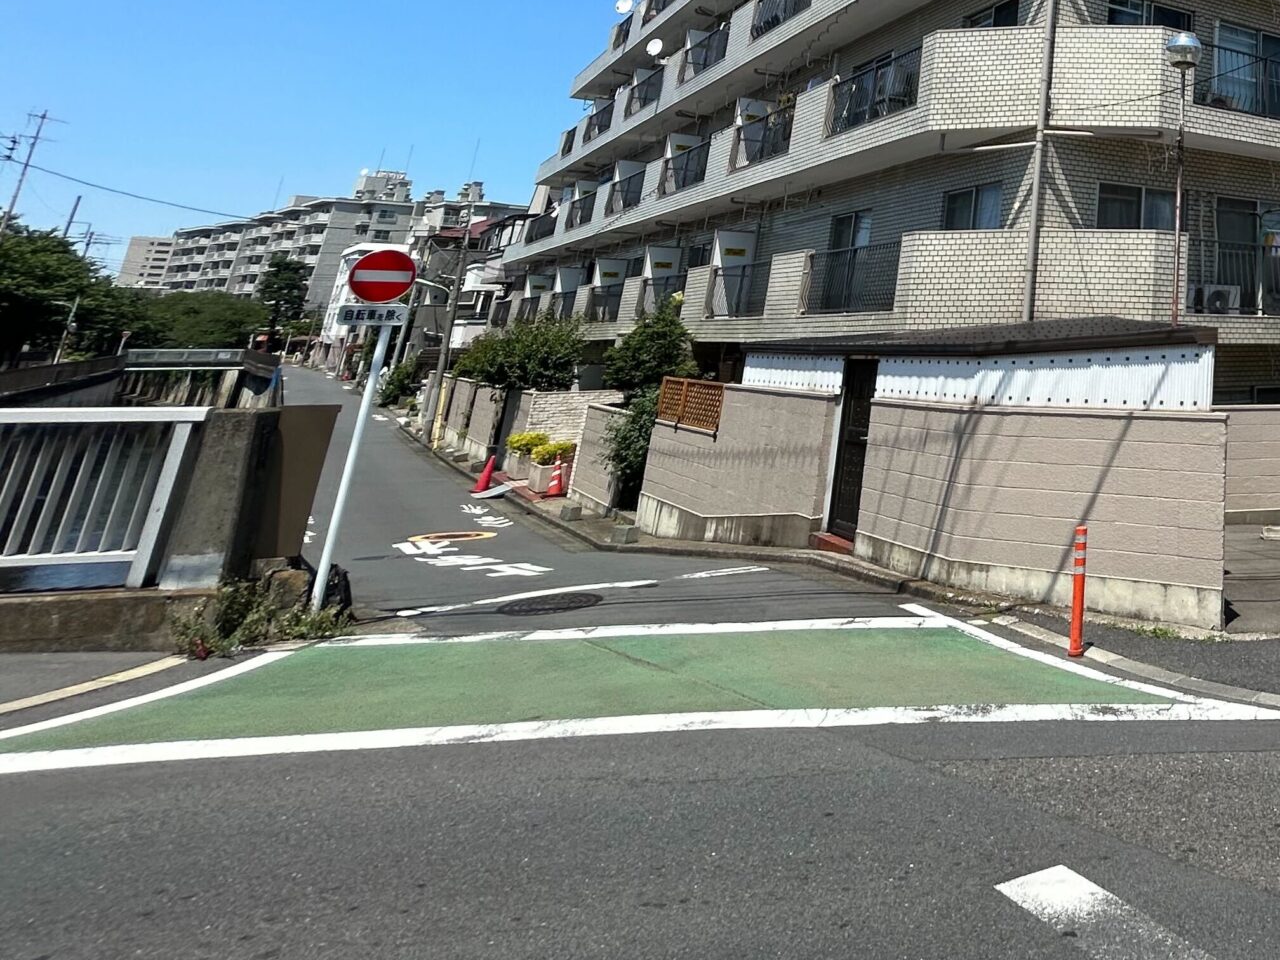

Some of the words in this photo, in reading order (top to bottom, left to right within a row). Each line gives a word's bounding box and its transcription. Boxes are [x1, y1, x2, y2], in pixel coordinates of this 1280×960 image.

[344, 309, 404, 321] 自転車を除く
